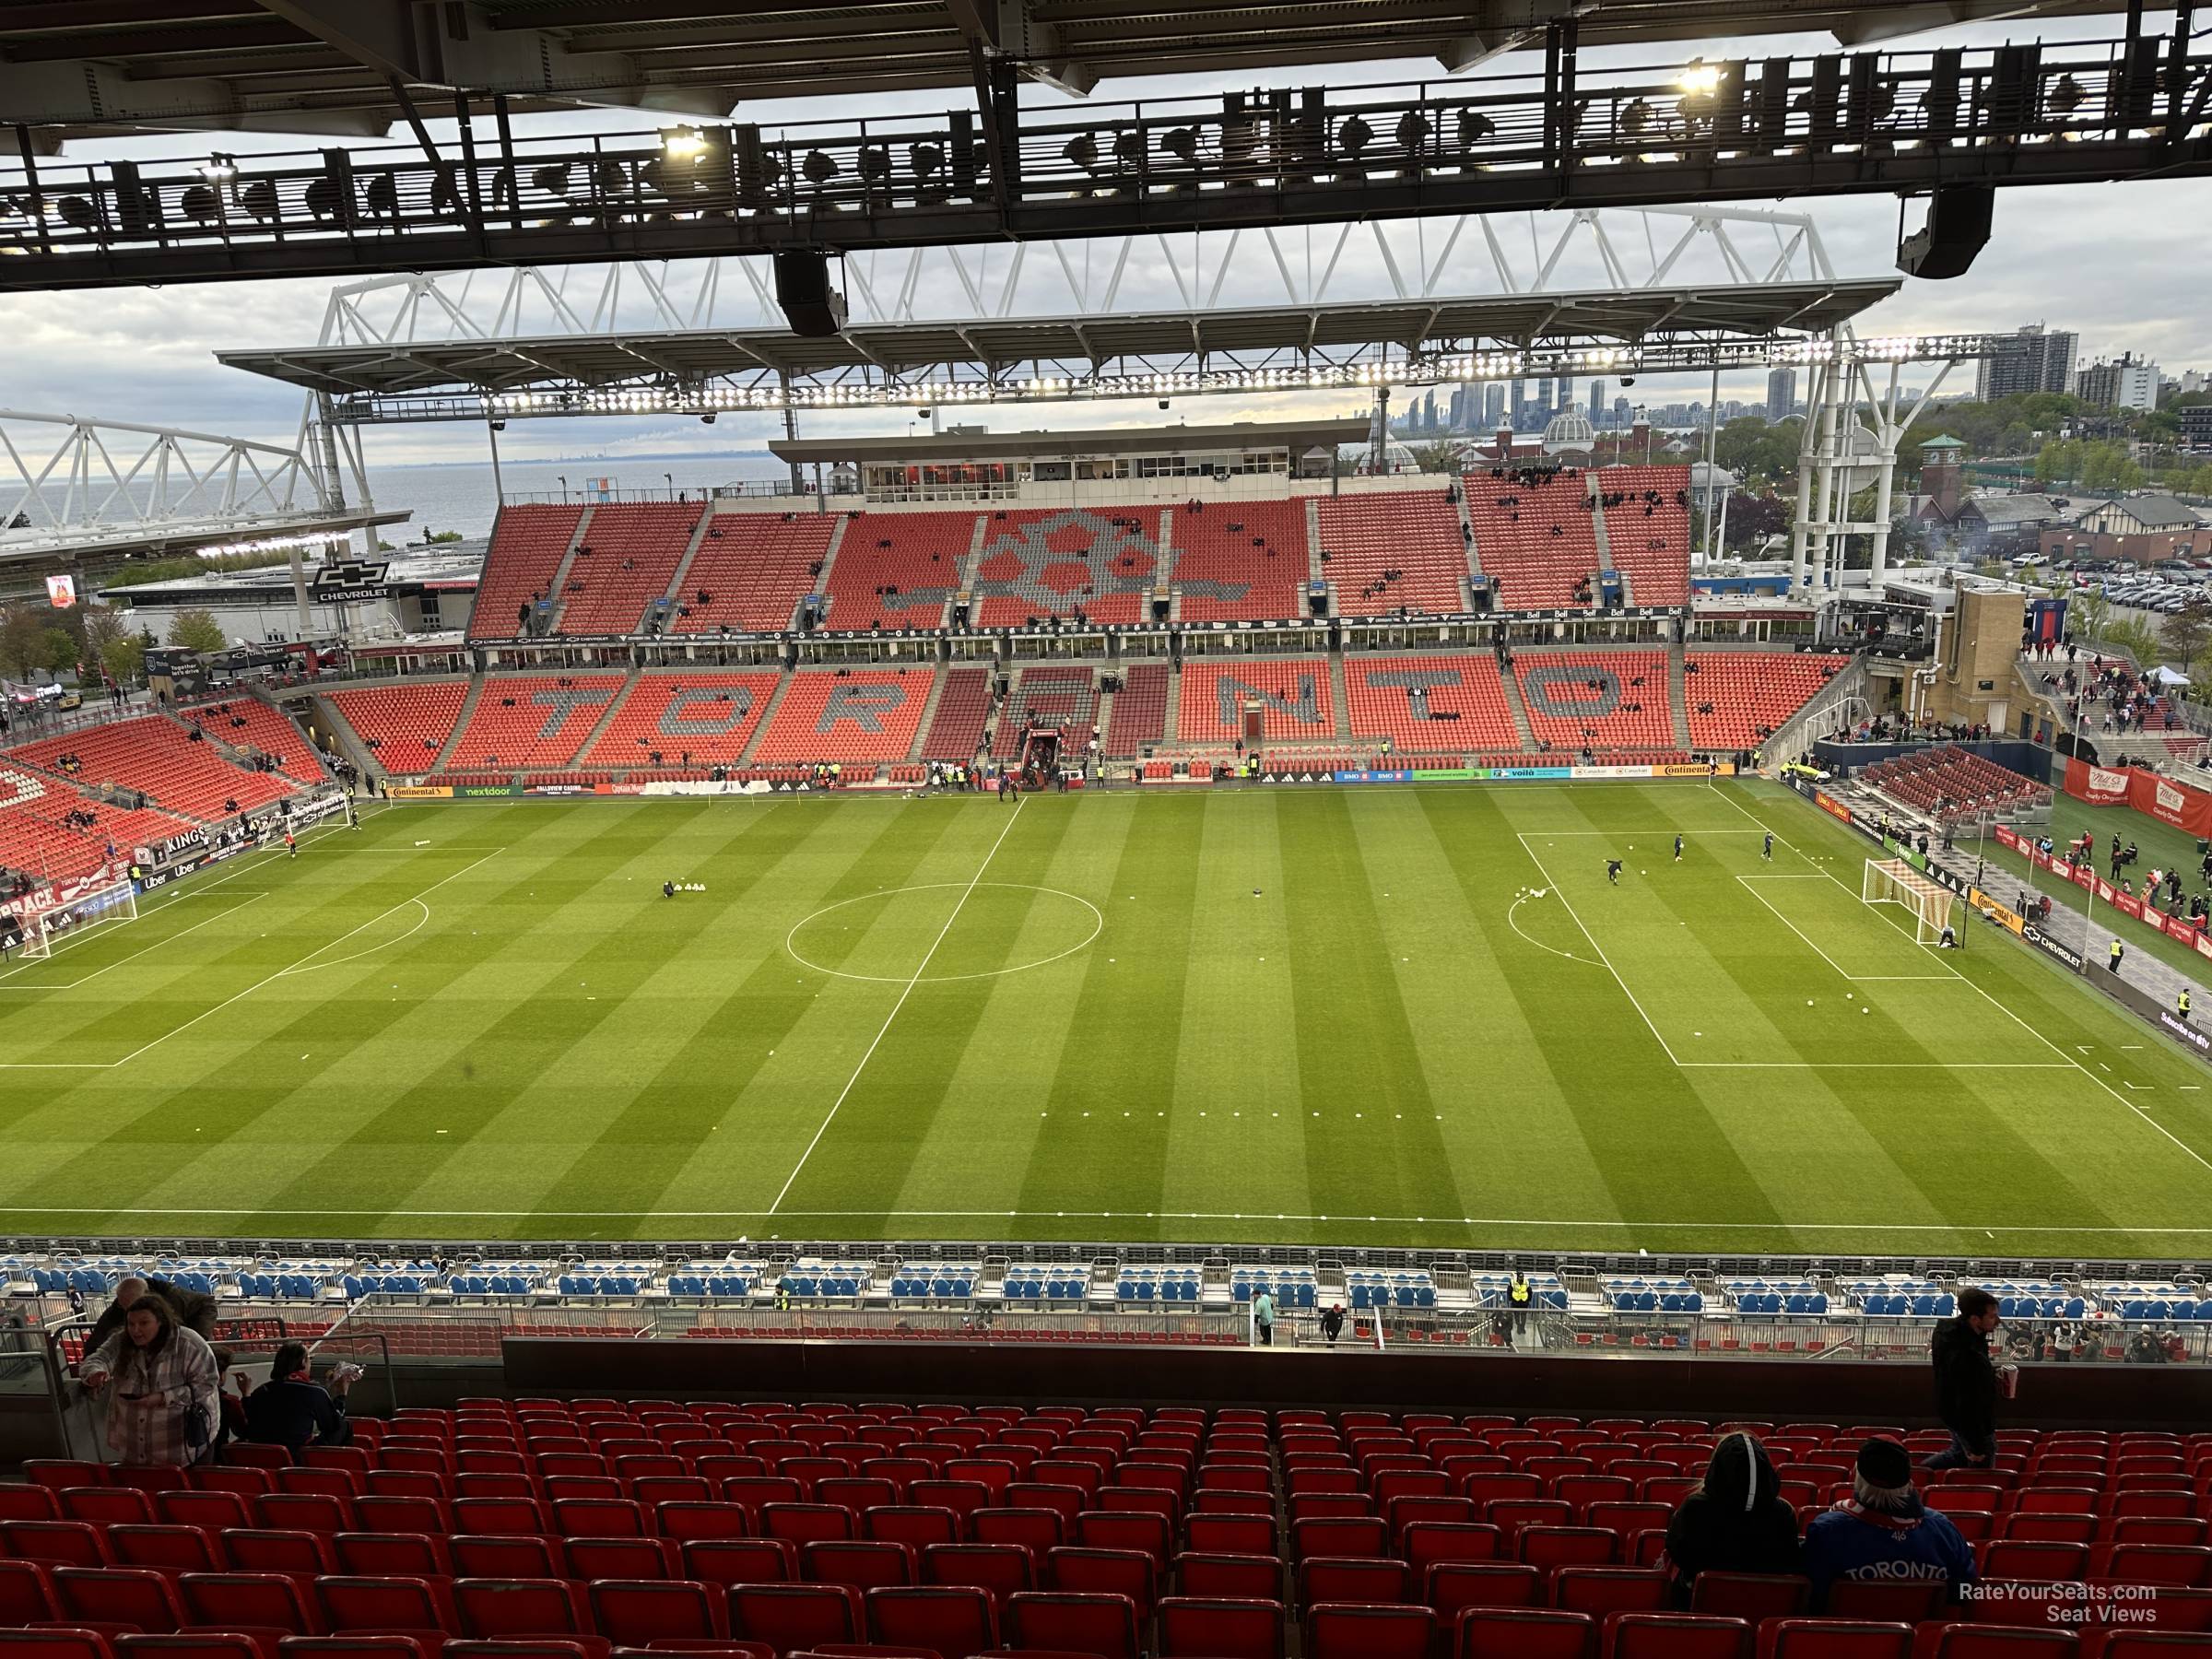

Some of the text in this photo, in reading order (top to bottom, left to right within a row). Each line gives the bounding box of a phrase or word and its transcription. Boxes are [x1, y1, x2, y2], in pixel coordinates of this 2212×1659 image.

[320, 588, 389, 602] CHEVROLET
[1526, 611, 1540, 619] Bell
[1611, 608, 1625, 617] Bell
[1640, 607, 1653, 616] Bell
[1668, 606, 1682, 615] Bell
[1665, 766, 1711, 776] Continenta
[393, 787, 436, 797] Continental
[465, 787, 511, 796] nextdoor
[167, 826, 206, 853] KINGS
[174, 862, 195, 878] Uber
[144, 875, 167, 889] Uber
[2041, 937, 2081, 968] CHEVROLET
[2160, 1011, 2188, 1036] Subscribe
[2188, 1031, 2196, 1041] on
[1844, 1560, 1947, 1582] TORONTO
